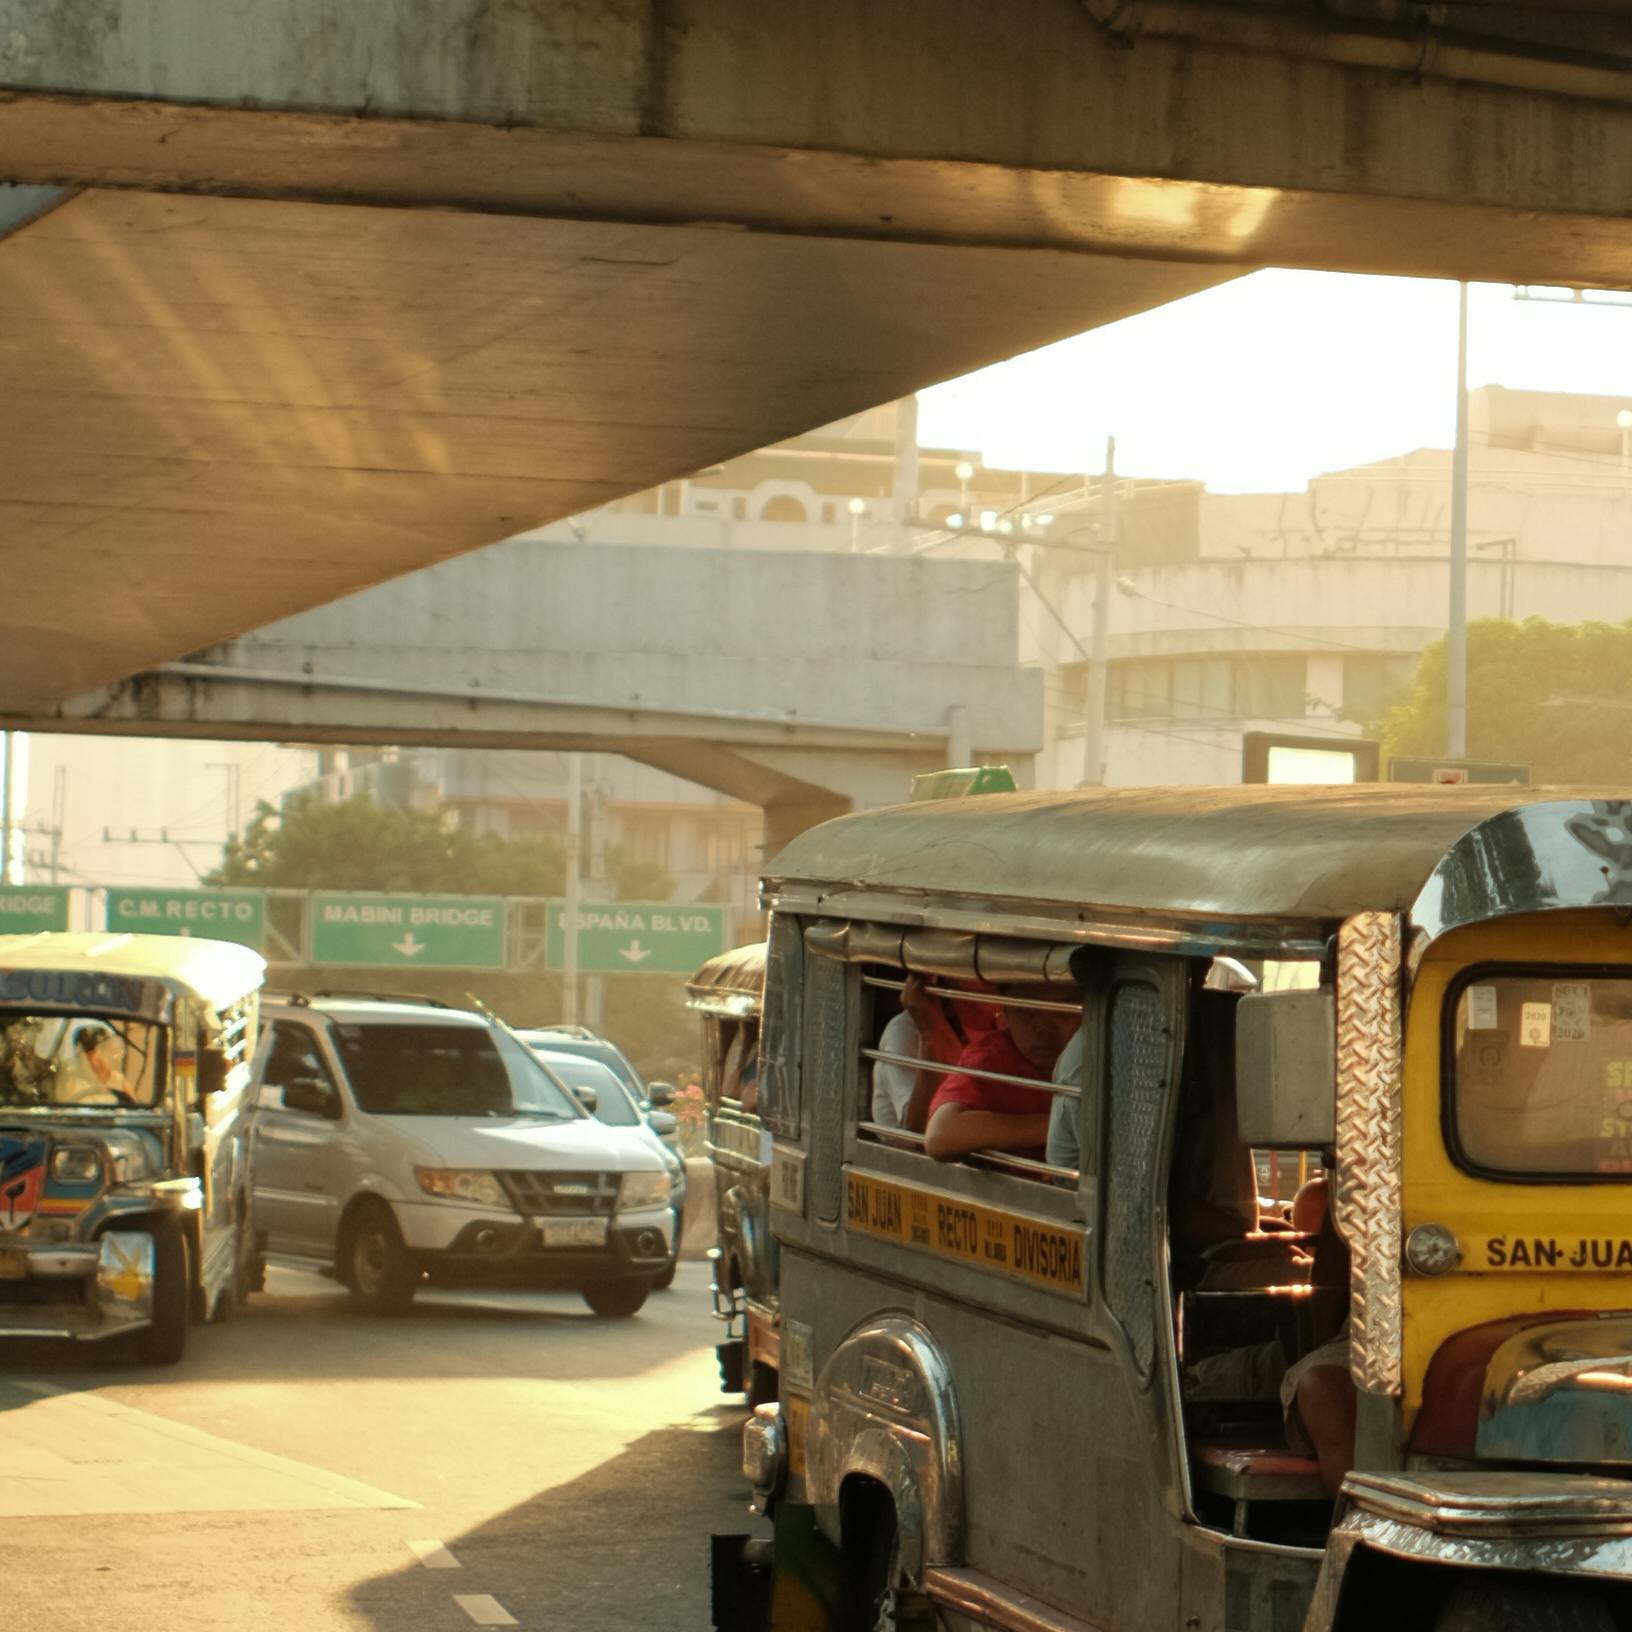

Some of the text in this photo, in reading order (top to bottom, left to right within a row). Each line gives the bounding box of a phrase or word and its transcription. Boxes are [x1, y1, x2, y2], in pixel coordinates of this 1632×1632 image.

[166, 901, 254, 920] RECTO
[324, 905, 493, 926] MABINI BRIDGE
[848, 1180, 869, 1225] SAN
[872, 1188, 902, 1235] JUAN
[938, 1202, 977, 1254] RECTO
[1014, 1223, 1081, 1286] DIVISORIA
[1487, 1237, 1556, 1267] SAN
